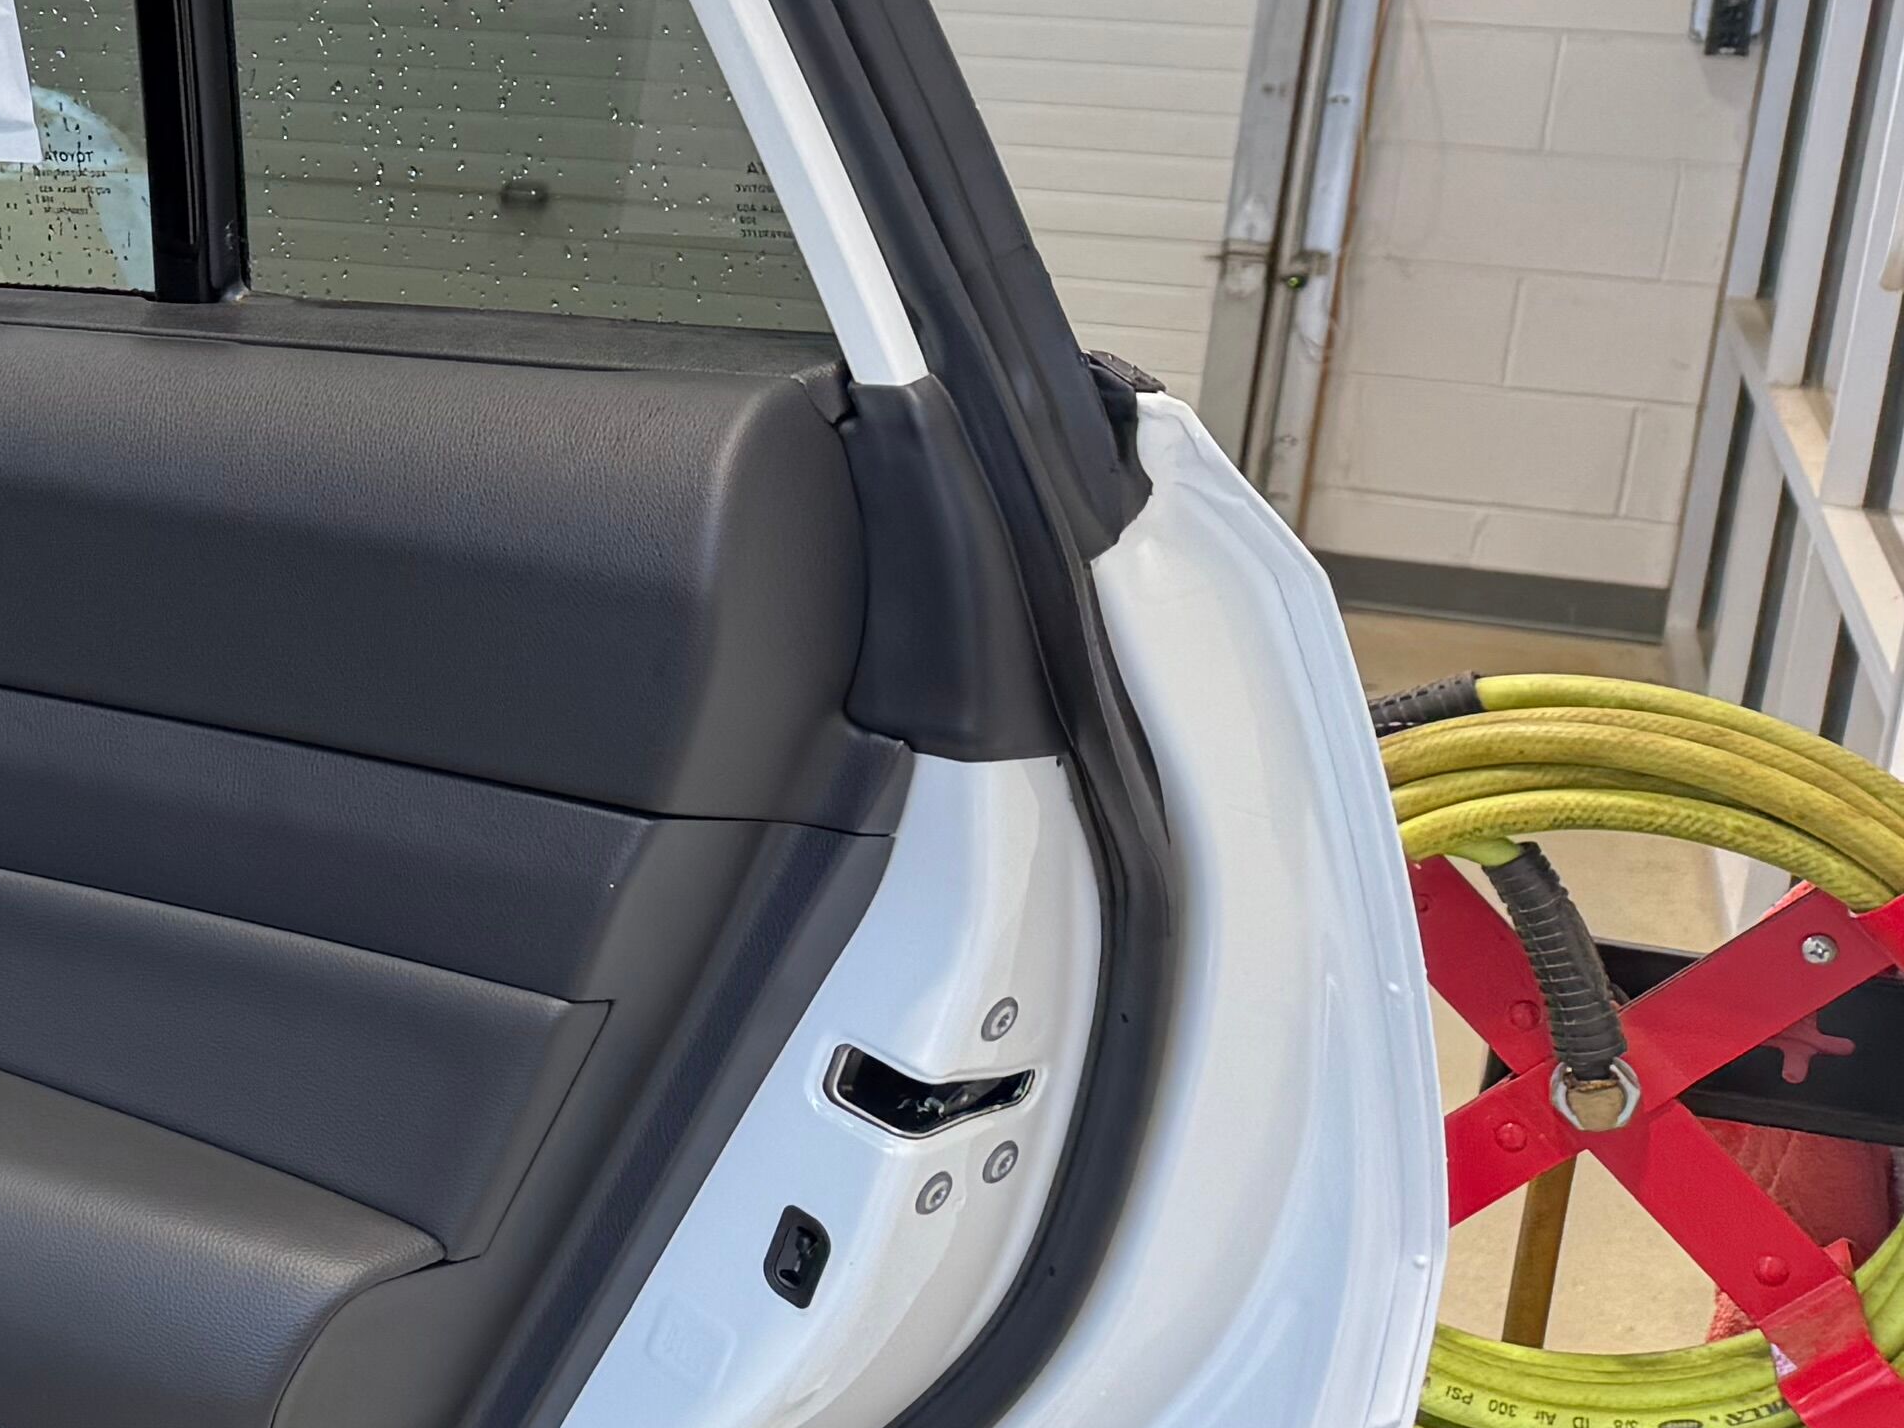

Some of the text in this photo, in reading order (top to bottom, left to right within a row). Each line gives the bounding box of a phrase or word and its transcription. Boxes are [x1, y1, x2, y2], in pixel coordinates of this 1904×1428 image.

[1445, 1384, 1474, 1406] PSI
[1488, 1399, 1519, 1418] 300
[1533, 1410, 1557, 1427] Air
